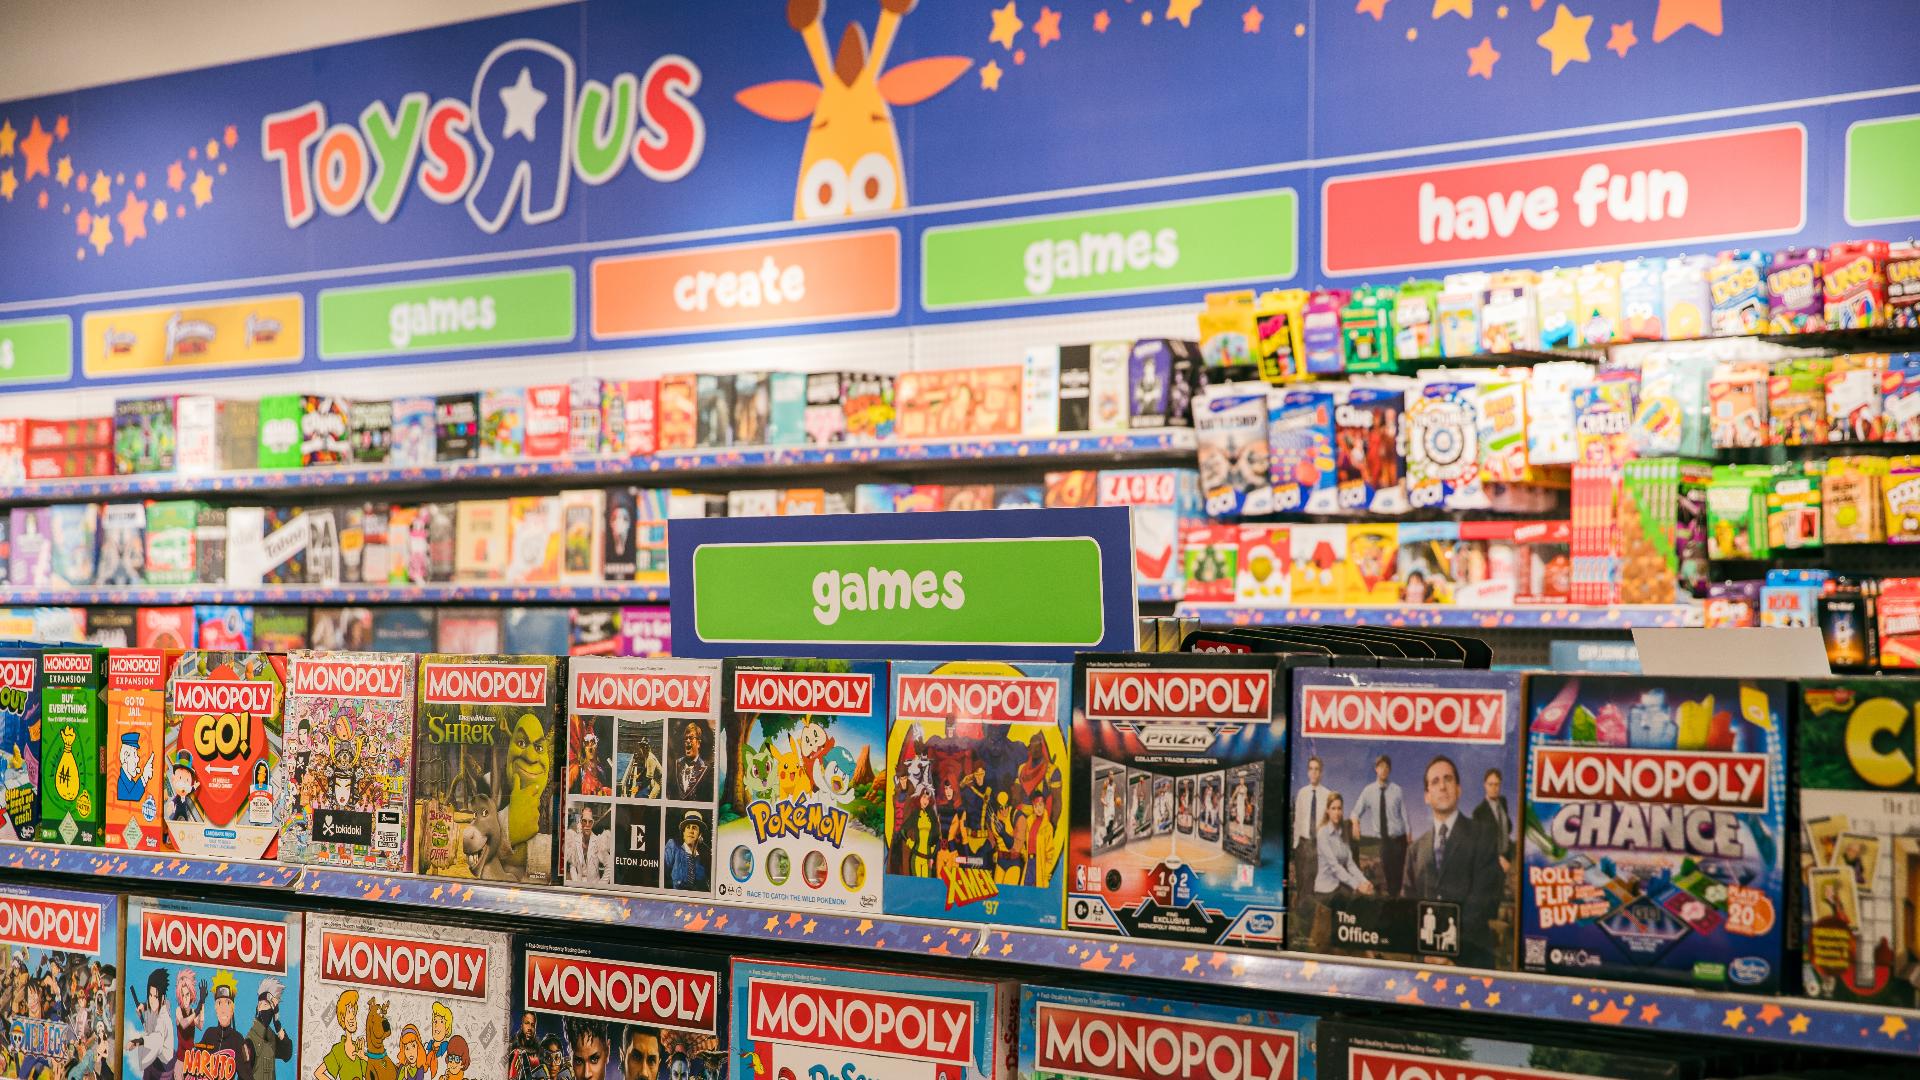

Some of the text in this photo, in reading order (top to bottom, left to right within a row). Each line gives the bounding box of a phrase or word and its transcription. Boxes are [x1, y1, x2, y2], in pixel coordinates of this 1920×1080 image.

[1418, 163, 1690, 246] have fun
[1024, 228, 1180, 296] games
[673, 256, 806, 312] create
[389, 292, 497, 349] games
[812, 566, 966, 626] games
[45, 657, 91, 671] MONOPOLY
[112, 659, 159, 672] MONOPOLY
[50, 675, 86, 683] EXPANSION
[116, 676, 154, 685] EXPANSION
[297, 665, 402, 694] MONOPOLY
[429, 670, 543, 699] MONOPOLY
[61, 693, 74, 703] BUY
[124, 696, 144, 706] GO TO
[177, 685, 271, 711] MONOPOLY
[579, 676, 708, 708] MONOPOLY
[740, 678, 869, 709] MONOPOLY
[902, 682, 1054, 717] MONOPOLY
[1093, 676, 1266, 714] MONOPOLY
[49, 704, 87, 714] EVERYTHING
[128, 707, 141, 716] JAIL
[1309, 694, 1499, 734] MONOPOLY
[194, 711, 250, 759] GO!
[1145, 734, 1208, 745] PRIZM
[1541, 755, 1762, 802] MONOPOLY
[15, 811, 32, 826] cash!
[335, 824, 362, 836] tokidoki
[1552, 803, 1744, 860] CHANCE
[615, 857, 659, 868] ELTON JOHN
[1159, 871, 1166, 886] 1
[1180, 873, 1188, 887] 2
[1529, 865, 1573, 886] ROLL
[746, 890, 762, 898] RACE
[771, 892, 788, 900] CATCH
[790, 893, 801, 901] THE
[802, 895, 816, 903] WILD
[1535, 884, 1574, 907] FLIP
[1153, 916, 1191, 925] EXCLUSIVE
[1337, 911, 1356, 924] The
[1540, 905, 1578, 929] BUY
[1729, 903, 1754, 927] 20
[146, 918, 283, 966] MONOPOLY
[1338, 925, 1379, 944] Office
[326, 937, 484, 992] MONOPOLY
[532, 961, 712, 1022] MONOPOLY
[756, 989, 968, 1054] MONOPOLY
[1046, 1015, 1290, 1080] MONOPOLY
[183, 1048, 236, 1080] NARUTO
